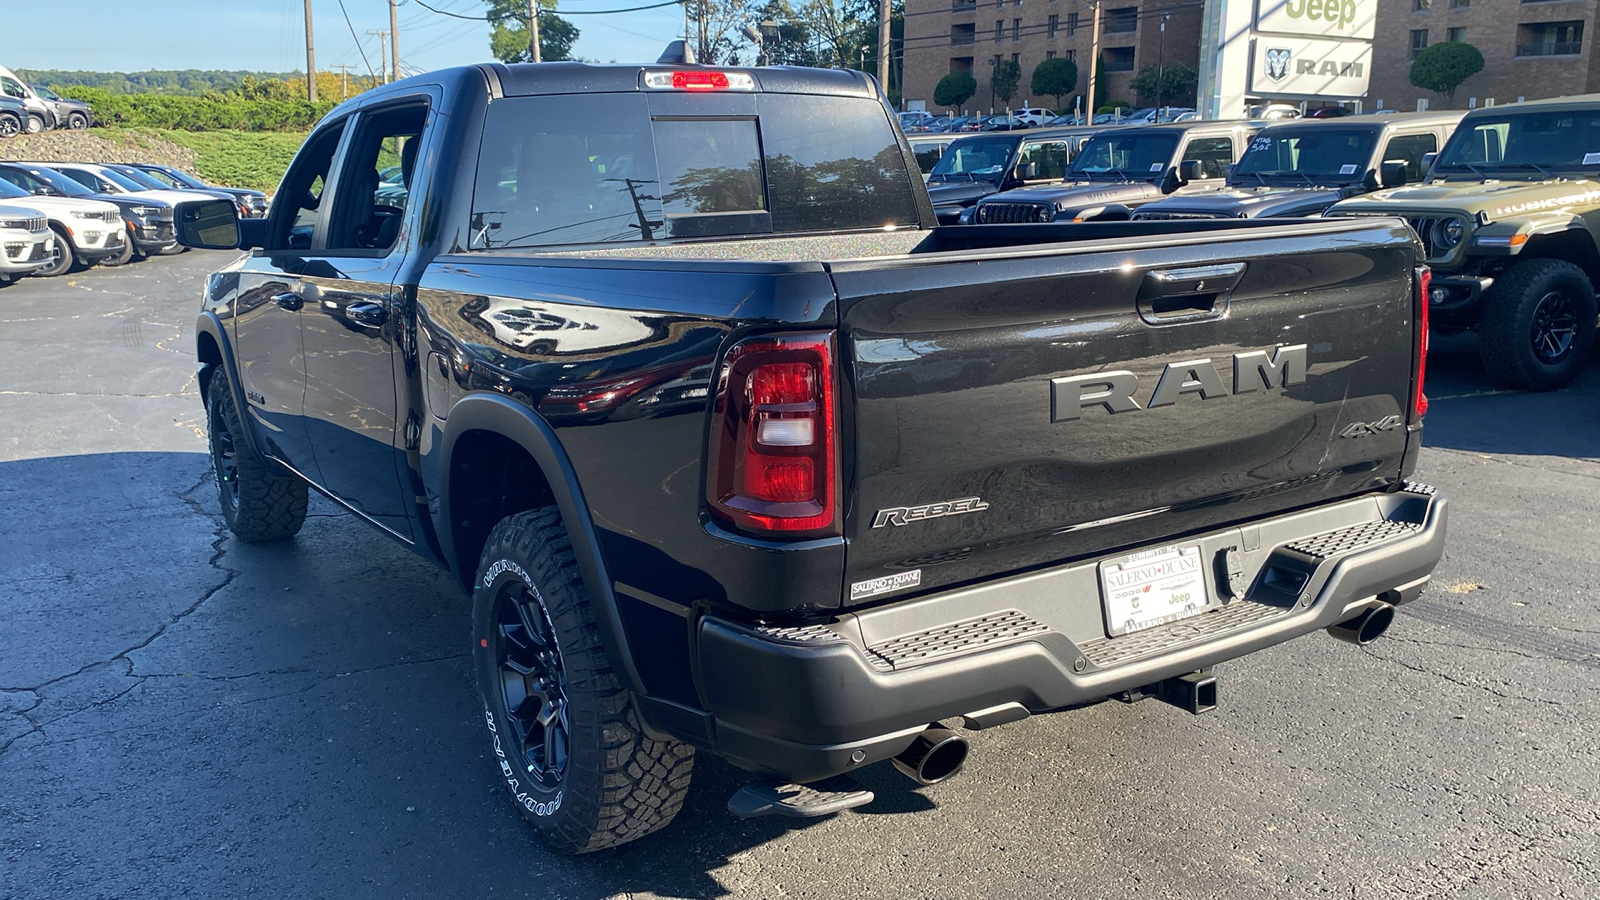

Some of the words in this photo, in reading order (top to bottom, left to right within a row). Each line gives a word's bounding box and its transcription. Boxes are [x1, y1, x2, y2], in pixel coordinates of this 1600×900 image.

[1286, 0, 1356, 30] Jeep
[1296, 58, 1363, 78] RAM
[1050, 343, 1308, 423] RAM
[870, 496, 990, 529] REBEL
[853, 580, 887, 593] SALERNO
[893, 573, 918, 584] DUANE
[1108, 565, 1157, 589] SALERNO
[1161, 557, 1198, 575] DUANE
[1169, 592, 1191, 605] Jeep
[1124, 617, 1164, 634] SALERNO
[1176, 607, 1202, 620] DUANE
